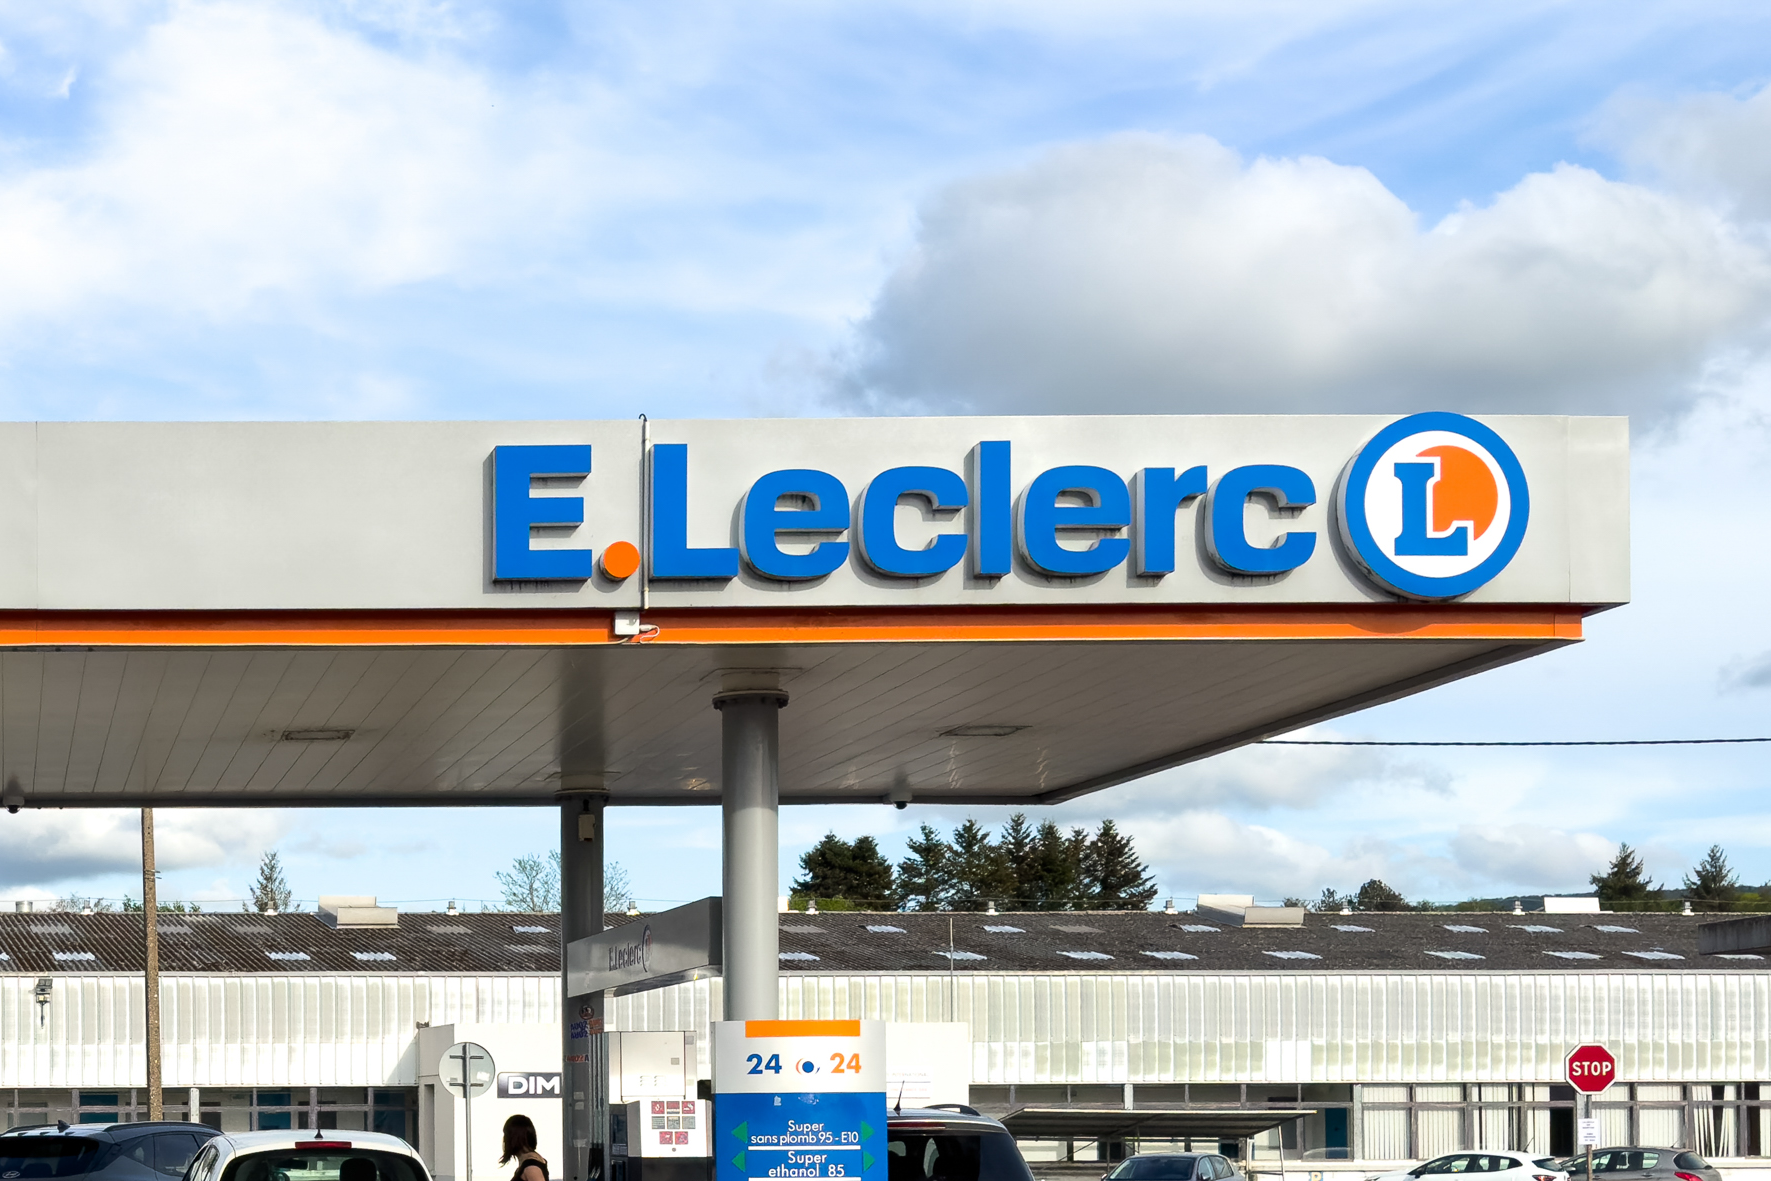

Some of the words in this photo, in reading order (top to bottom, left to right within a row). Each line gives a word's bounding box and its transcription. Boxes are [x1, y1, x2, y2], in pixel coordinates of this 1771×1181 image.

[494, 440, 1317, 581] E.Leclerc
[1394, 462, 1468, 556] L
[746, 1053, 782, 1075] 24
[830, 1052, 862, 1074] 24
[1572, 1061, 1612, 1077] STOP
[508, 1075, 561, 1095] DIM
[788, 1120, 825, 1134] Super
[751, 1134, 778, 1144] sans
[818, 1131, 833, 1144] 95
[841, 1131, 859, 1143] E10
[788, 1151, 828, 1166] Super
[768, 1164, 820, 1177] ethanol
[828, 1164, 845, 1177] 85
